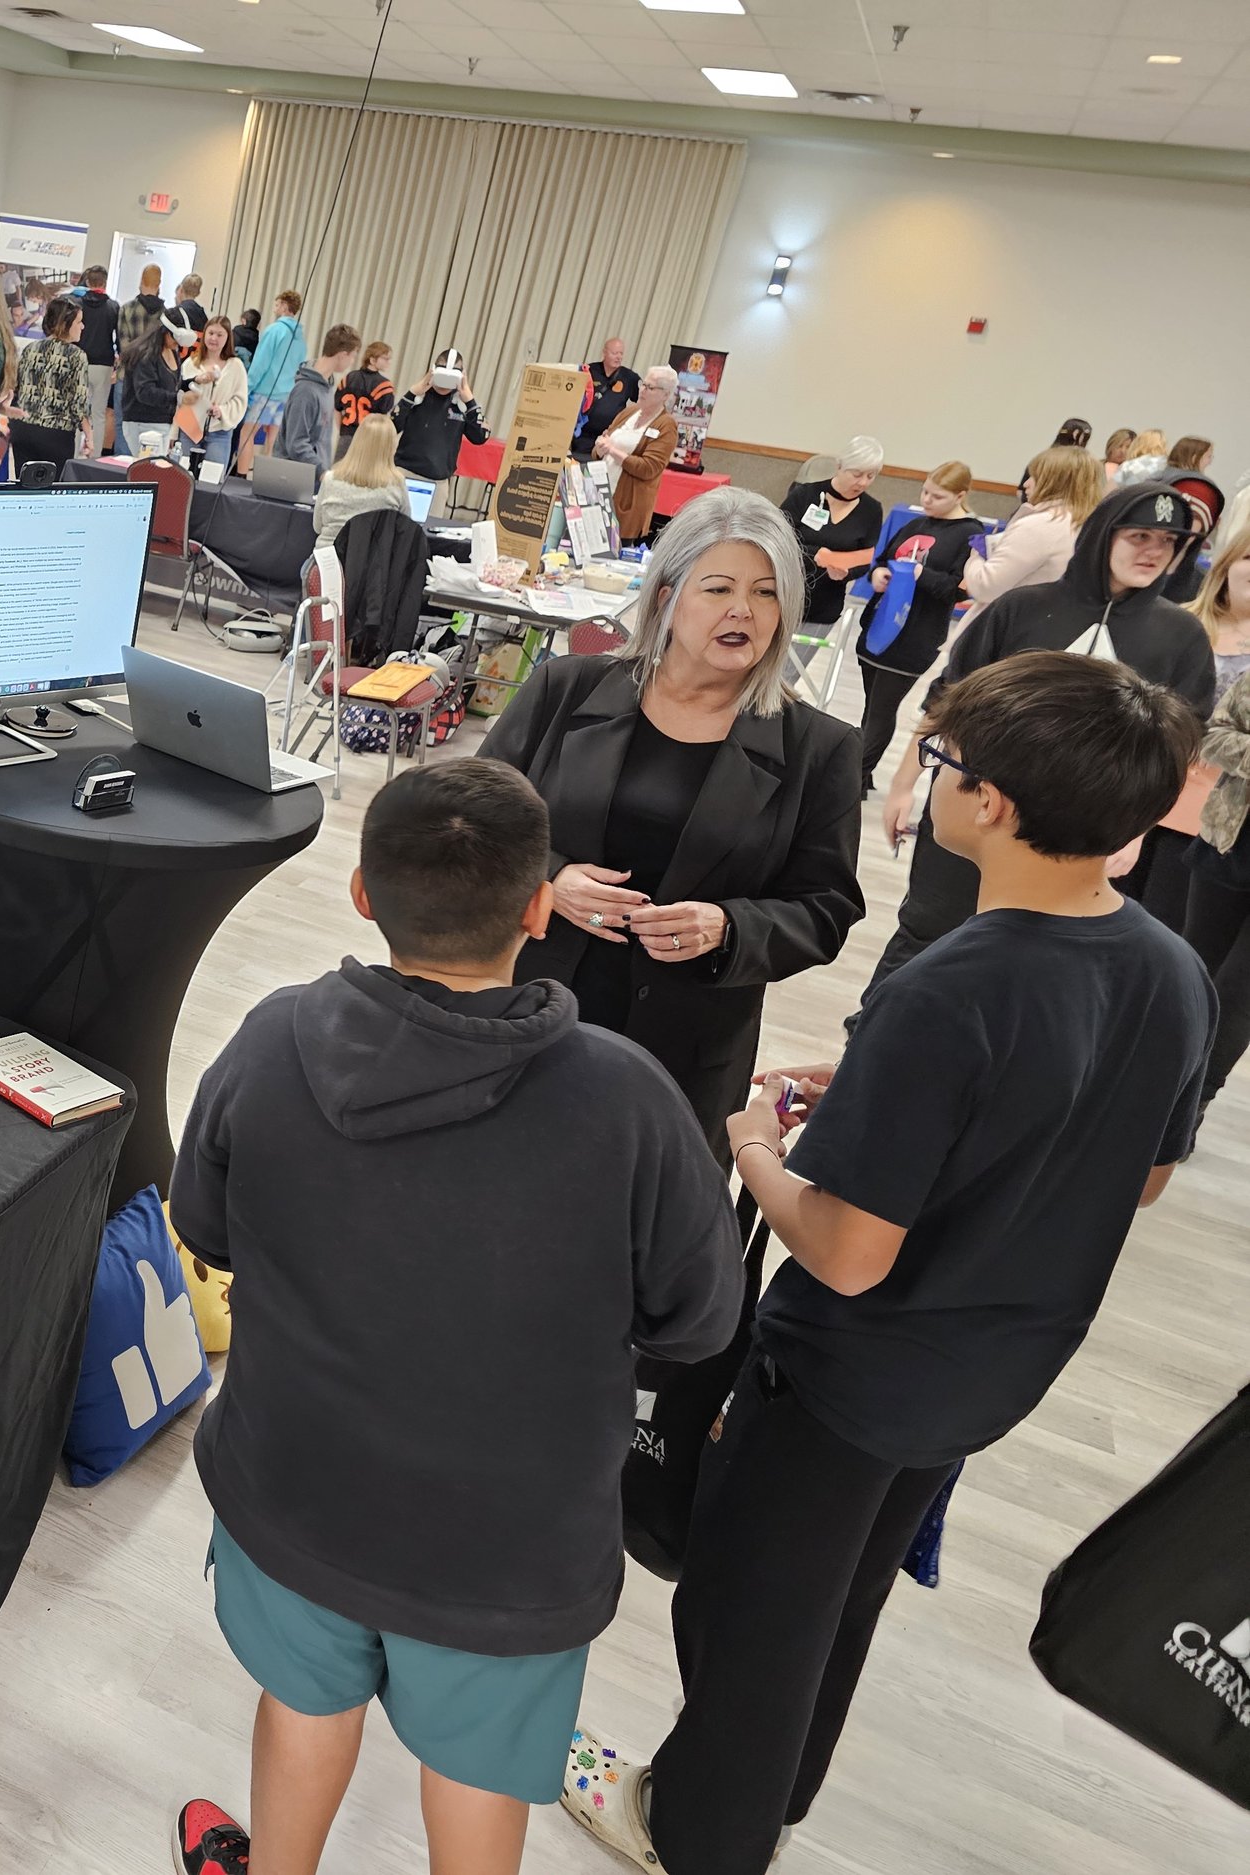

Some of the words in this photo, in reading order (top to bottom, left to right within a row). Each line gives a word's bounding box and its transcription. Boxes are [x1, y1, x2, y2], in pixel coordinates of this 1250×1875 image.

[150, 193, 169, 207] EXIT
[341, 394, 372, 426] 36
[10, 1057, 51, 1073] STORY
[10, 1066, 54, 1083] BRAND
